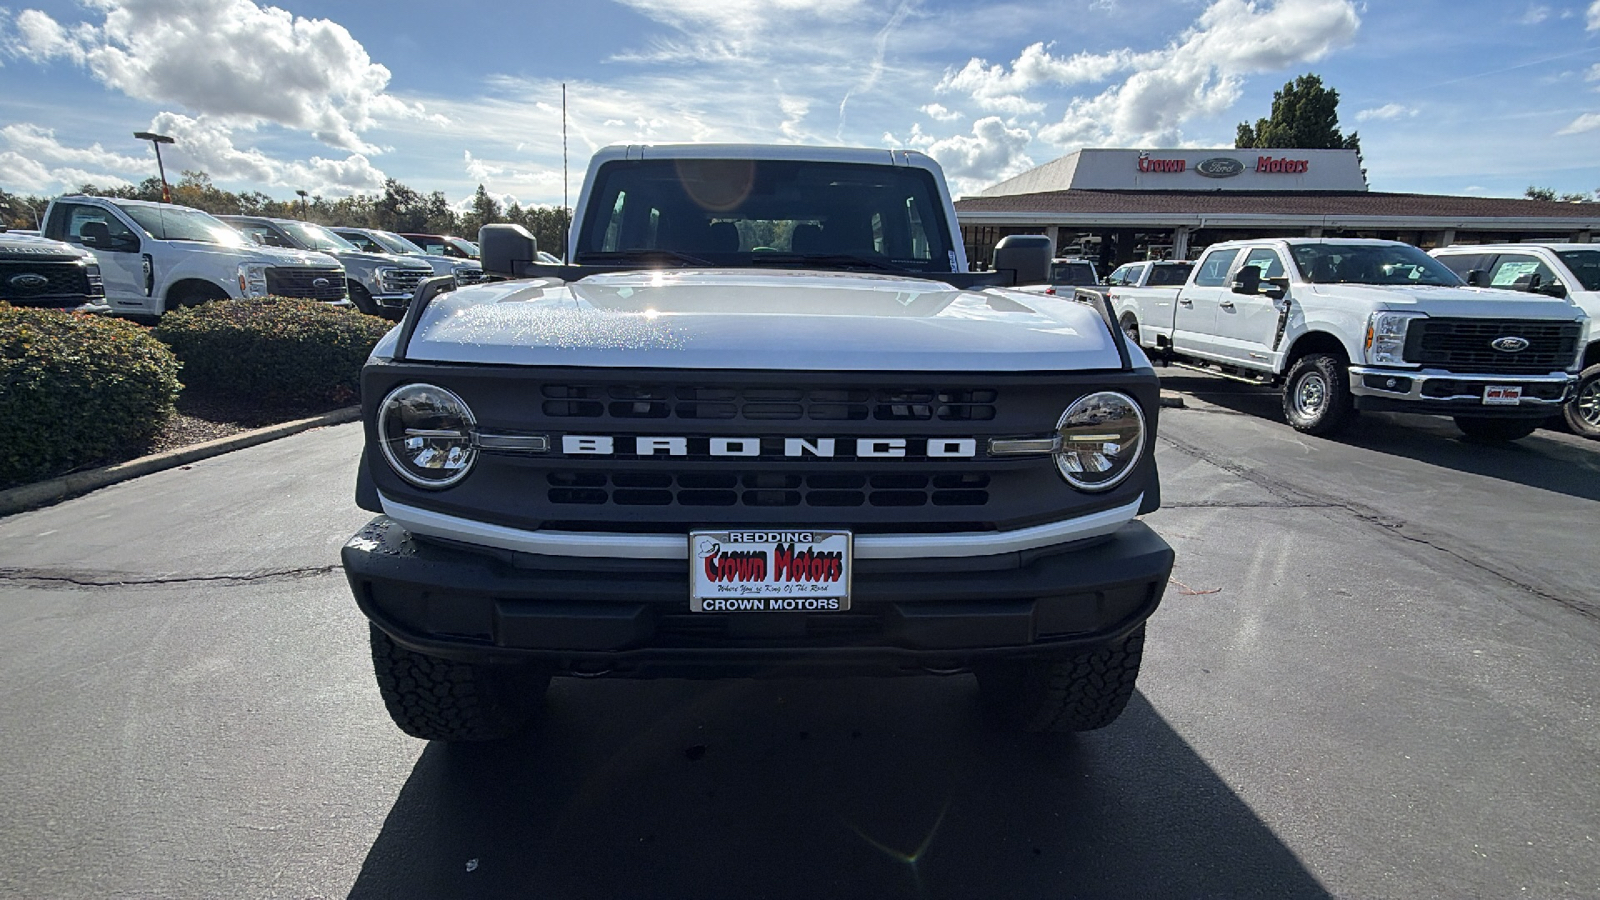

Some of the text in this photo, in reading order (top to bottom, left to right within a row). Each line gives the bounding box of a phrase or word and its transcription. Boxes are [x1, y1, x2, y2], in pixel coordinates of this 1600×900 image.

[1138, 156, 1309, 173] Crown Ford Motors
[562, 435, 977, 458] BRONCO
[730, 532, 813, 543] REDDING
[704, 543, 843, 583] Crown Motors
[718, 584, 739, 592] Where
[764, 584, 782, 593] King
[783, 584, 794, 593] Of
[796, 584, 808, 592] The
[809, 584, 829, 592] Road
[703, 598, 839, 611] CROWN MOTORS
